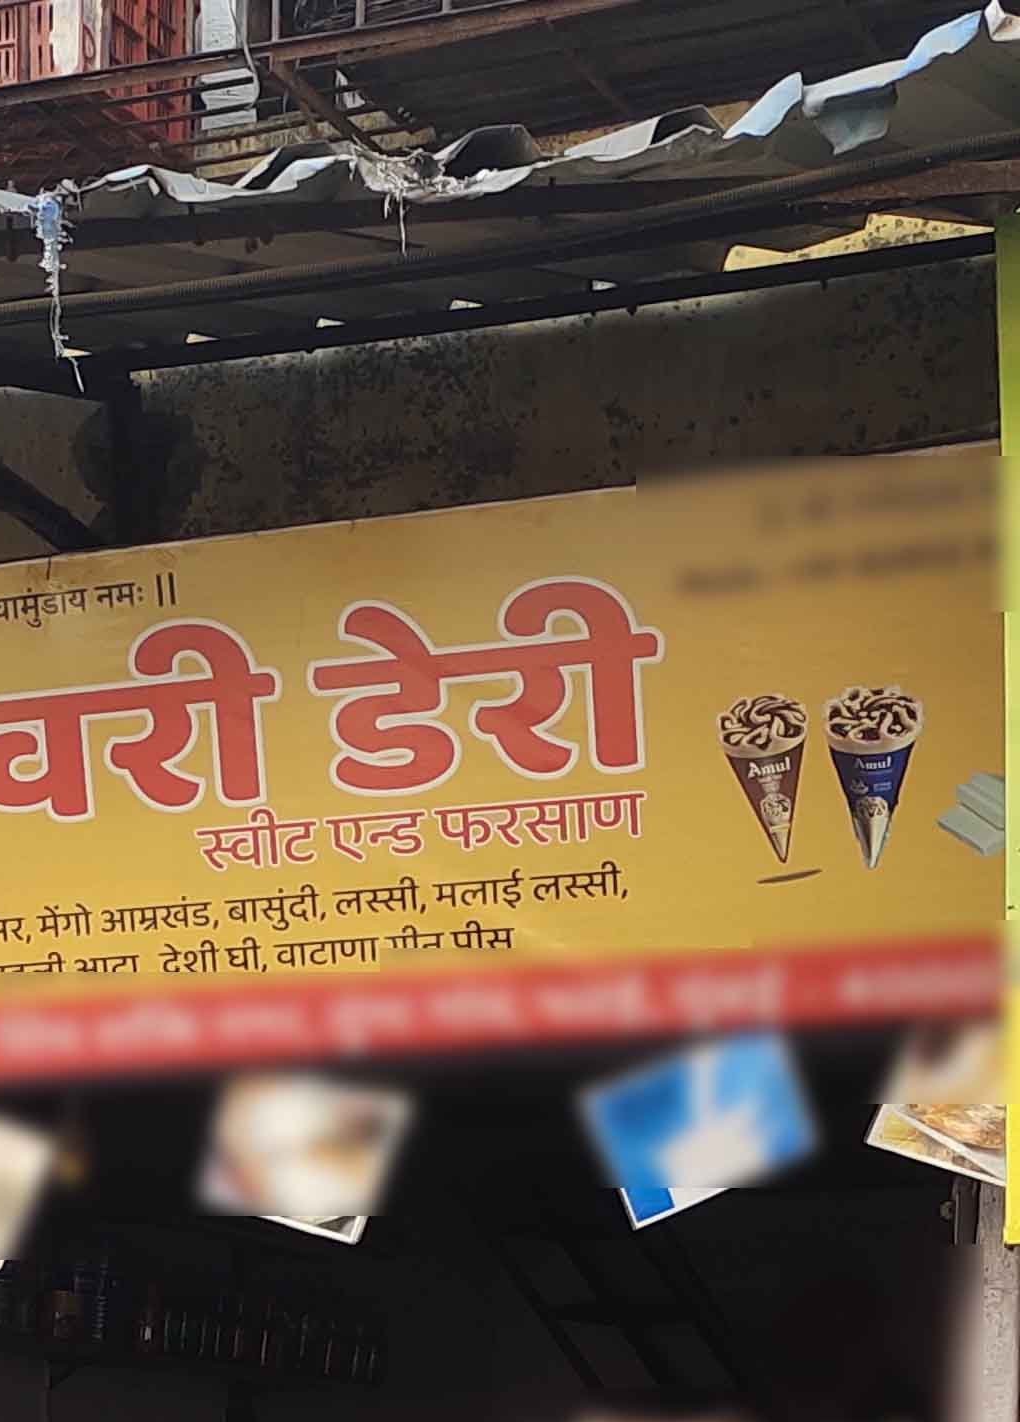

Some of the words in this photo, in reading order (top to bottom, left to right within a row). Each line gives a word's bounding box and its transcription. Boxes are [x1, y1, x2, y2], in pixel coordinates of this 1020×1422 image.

[94, 582, 145, 609] नमः
[309, 576, 664, 794] डेरी
[747, 756, 792, 779] Amul
[853, 755, 892, 771] Amul
[195, 809, 317, 871] स्वीट
[325, 810, 426, 860] एन्ड
[435, 793, 646, 850] फरसाण
[36, 903, 92, 940] मेंगो
[224, 884, 327, 931] बासुंदी,
[332, 876, 428, 916] लस्सी,
[432, 868, 524, 909] मलाई
[530, 859, 629, 901] लस्सी,
[274, 936, 380, 970] वाटाणा
